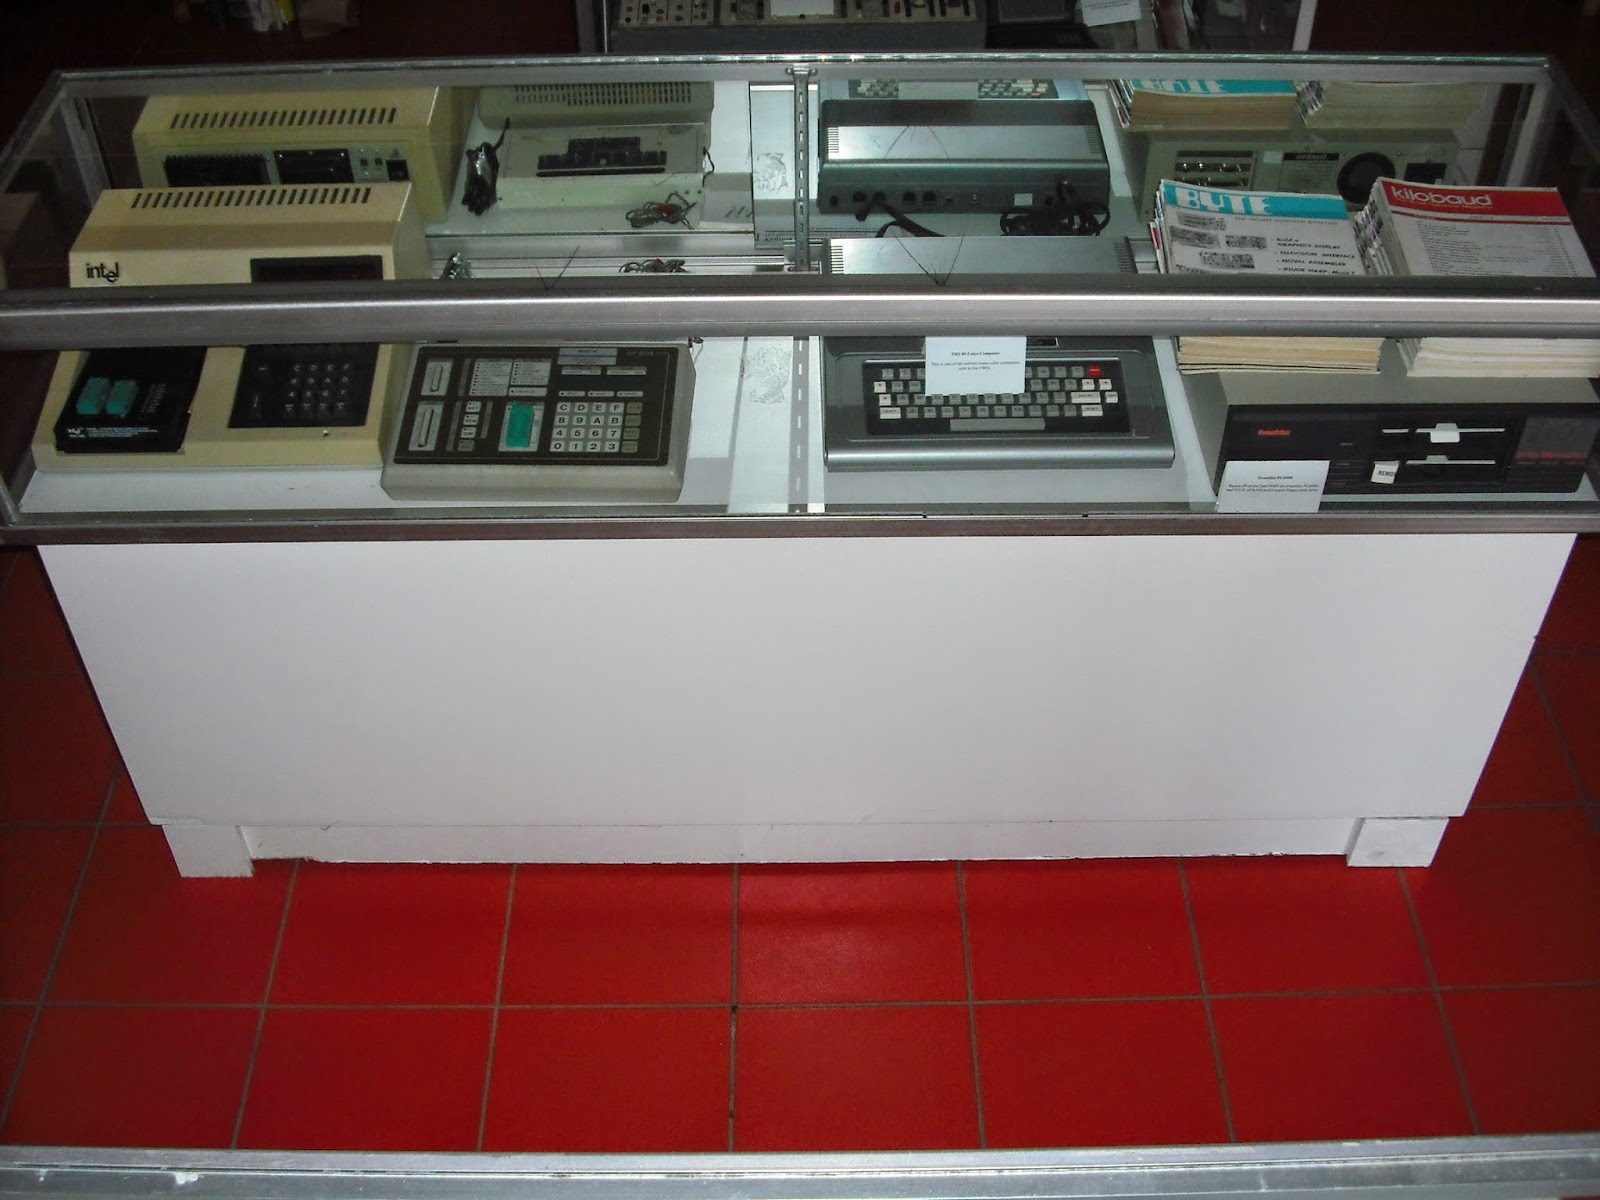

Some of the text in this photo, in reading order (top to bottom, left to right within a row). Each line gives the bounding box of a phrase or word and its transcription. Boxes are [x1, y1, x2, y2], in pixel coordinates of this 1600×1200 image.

[1174, 186, 1272, 215] BYTE
[1391, 186, 1493, 206] kilobaud
[86, 262, 119, 283] intel
